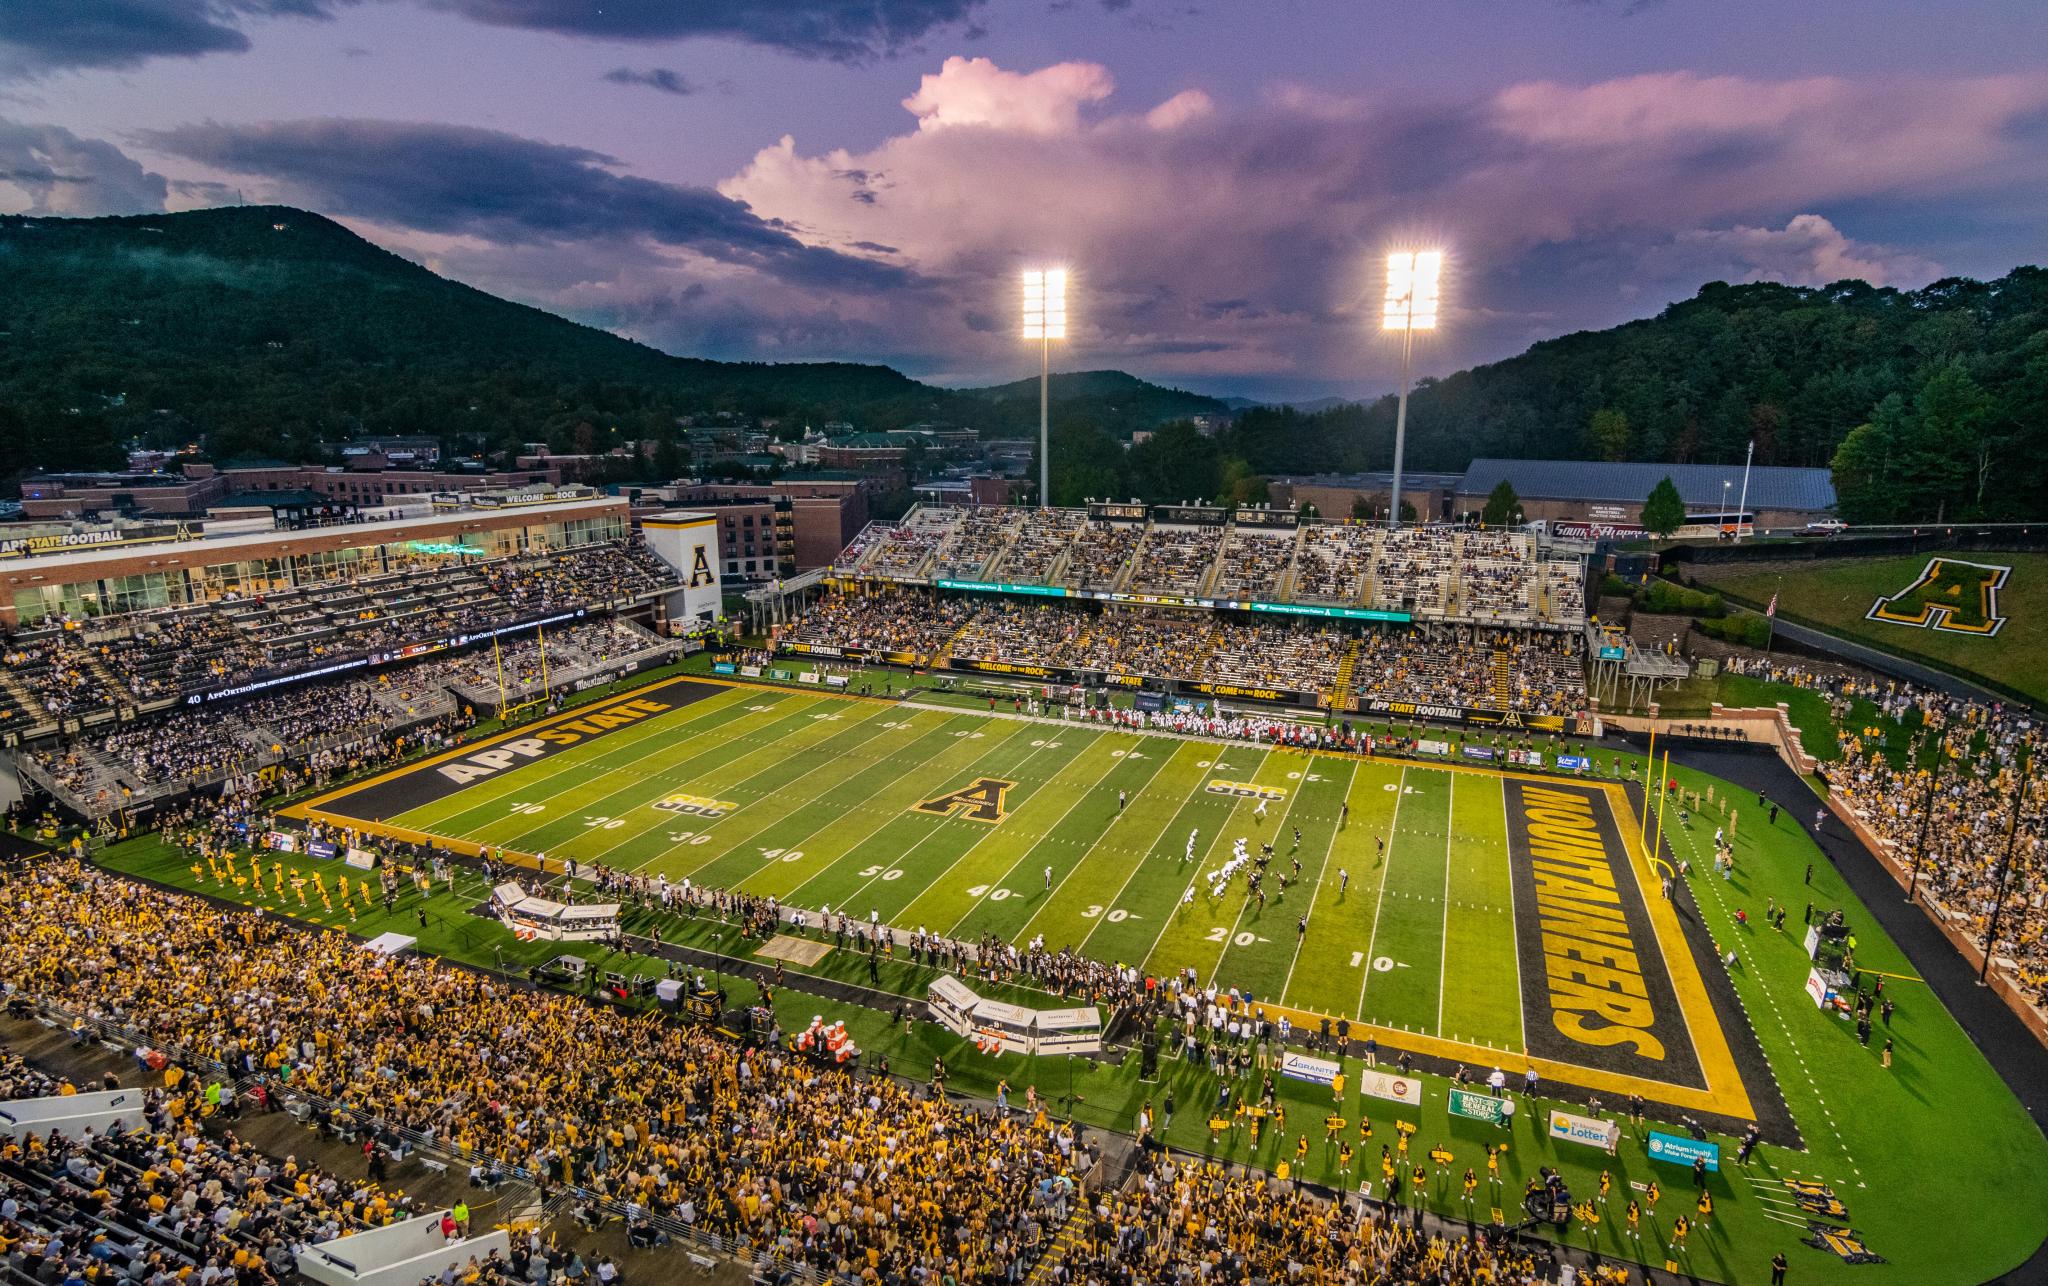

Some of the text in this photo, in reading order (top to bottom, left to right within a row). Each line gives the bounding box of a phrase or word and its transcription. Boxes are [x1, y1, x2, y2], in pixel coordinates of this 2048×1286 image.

[506, 493, 544, 503] WELCOME
[557, 490, 577, 499] ROCK
[27, 535, 61, 549] STATE
[61, 531, 123, 545] FOOTBALL
[688, 544, 717, 589] A
[1865, 557, 2012, 637] A
[383, 653, 389, 661] 0
[794, 644, 811, 653] STATE
[811, 646, 842, 656] FOOTBALL
[979, 661, 1012, 673] WELCOME
[1025, 667, 1045, 676] ROCK
[1105, 674, 1143, 686] APP STATE
[1200, 683, 1238, 696] WECOME
[1253, 690, 1277, 699] ROCK
[187, 695, 201, 704] 40
[1369, 701, 1463, 719] APP STATE FOOTBALL
[3, 733, 18, 748] 71
[437, 698, 672, 784] APP STATE
[1030, 740, 1063, 749] 50
[1286, 772, 1323, 782] 20
[910, 777, 1020, 824] A
[511, 803, 545, 814] 10
[585, 817, 626, 829] 20
[670, 832, 711, 844] 30
[764, 847, 804, 862] 40
[858, 864, 904, 881] 50
[967, 884, 1010, 901] 40
[1081, 904, 1128, 922] 30
[1521, 785, 1665, 1061] MOUNTAINEERS
[1204, 927, 1255, 946] 20
[1348, 950, 1394, 972] 10
[1298, 1062, 1335, 1075] GRANITE
[1463, 1094, 1484, 1105] MAST
[1463, 1102, 1497, 1114] GENERAL
[1468, 1110, 1490, 1120] STORE
[1571, 1127, 1609, 1145] Lottery
[1664, 1142, 1712, 1158] Atrium Health
[1664, 1149, 1680, 1157] Wake
[1681, 1152, 1698, 1161] Forest
